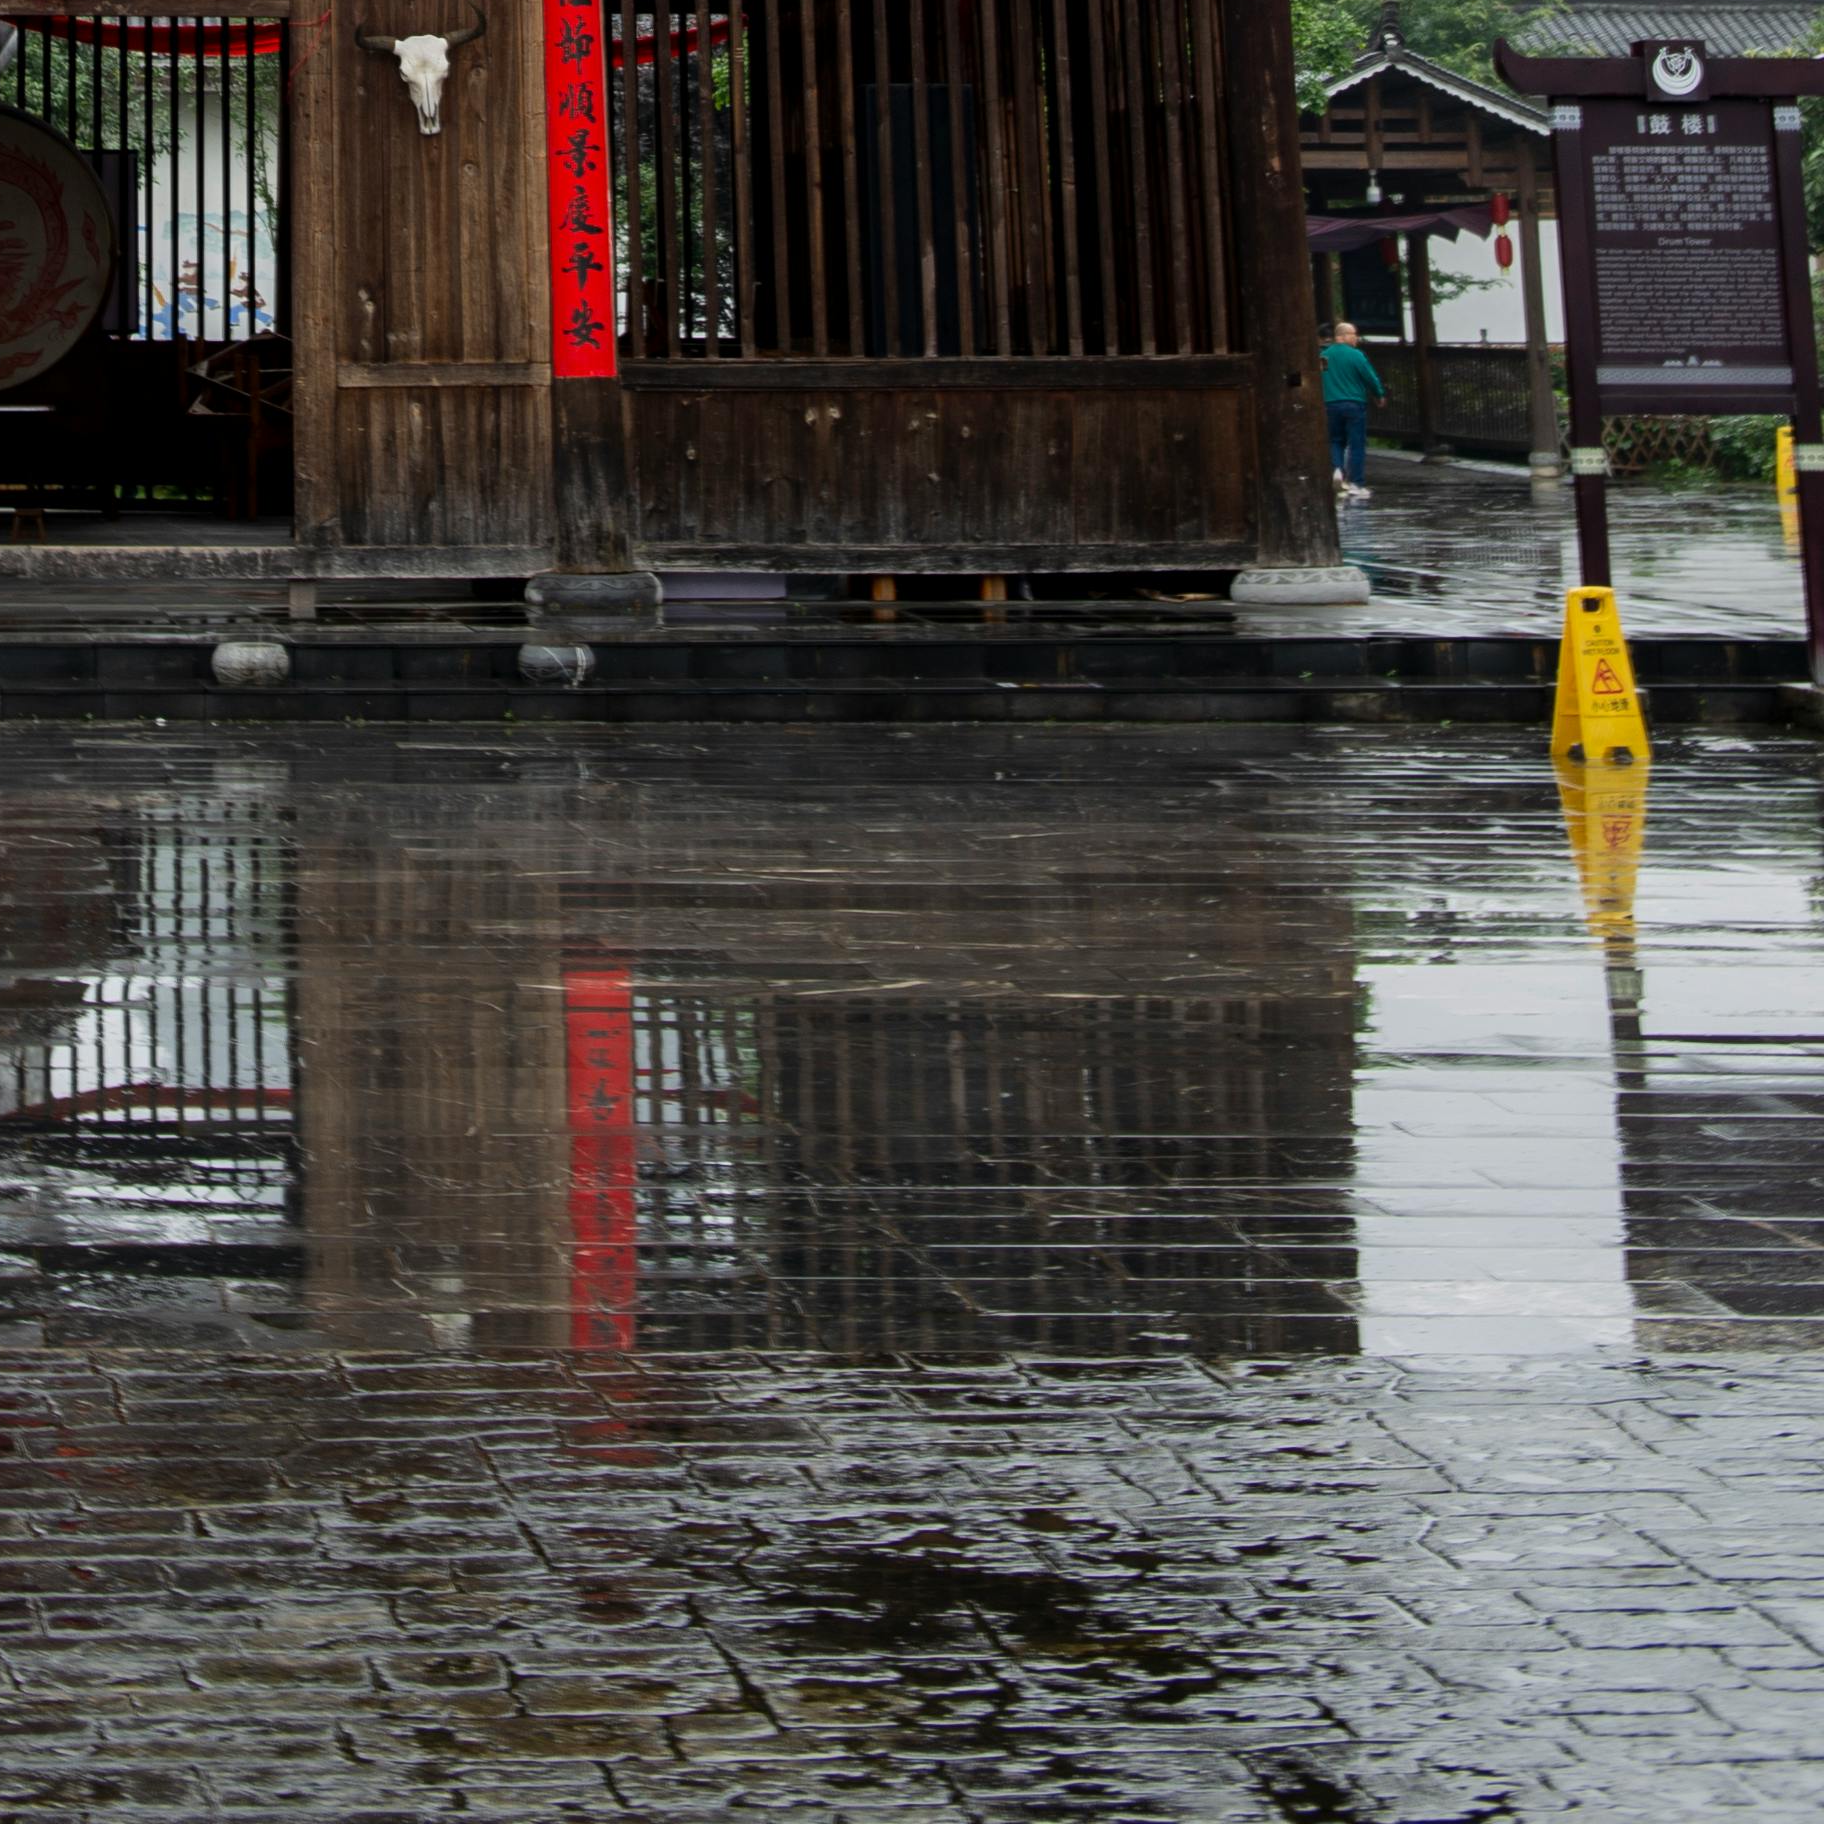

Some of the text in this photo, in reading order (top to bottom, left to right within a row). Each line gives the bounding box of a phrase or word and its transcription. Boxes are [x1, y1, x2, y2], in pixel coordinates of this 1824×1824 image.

[1648, 112, 1704, 135] 鼓楼
[1657, 236, 1712, 248] Drum Tower
